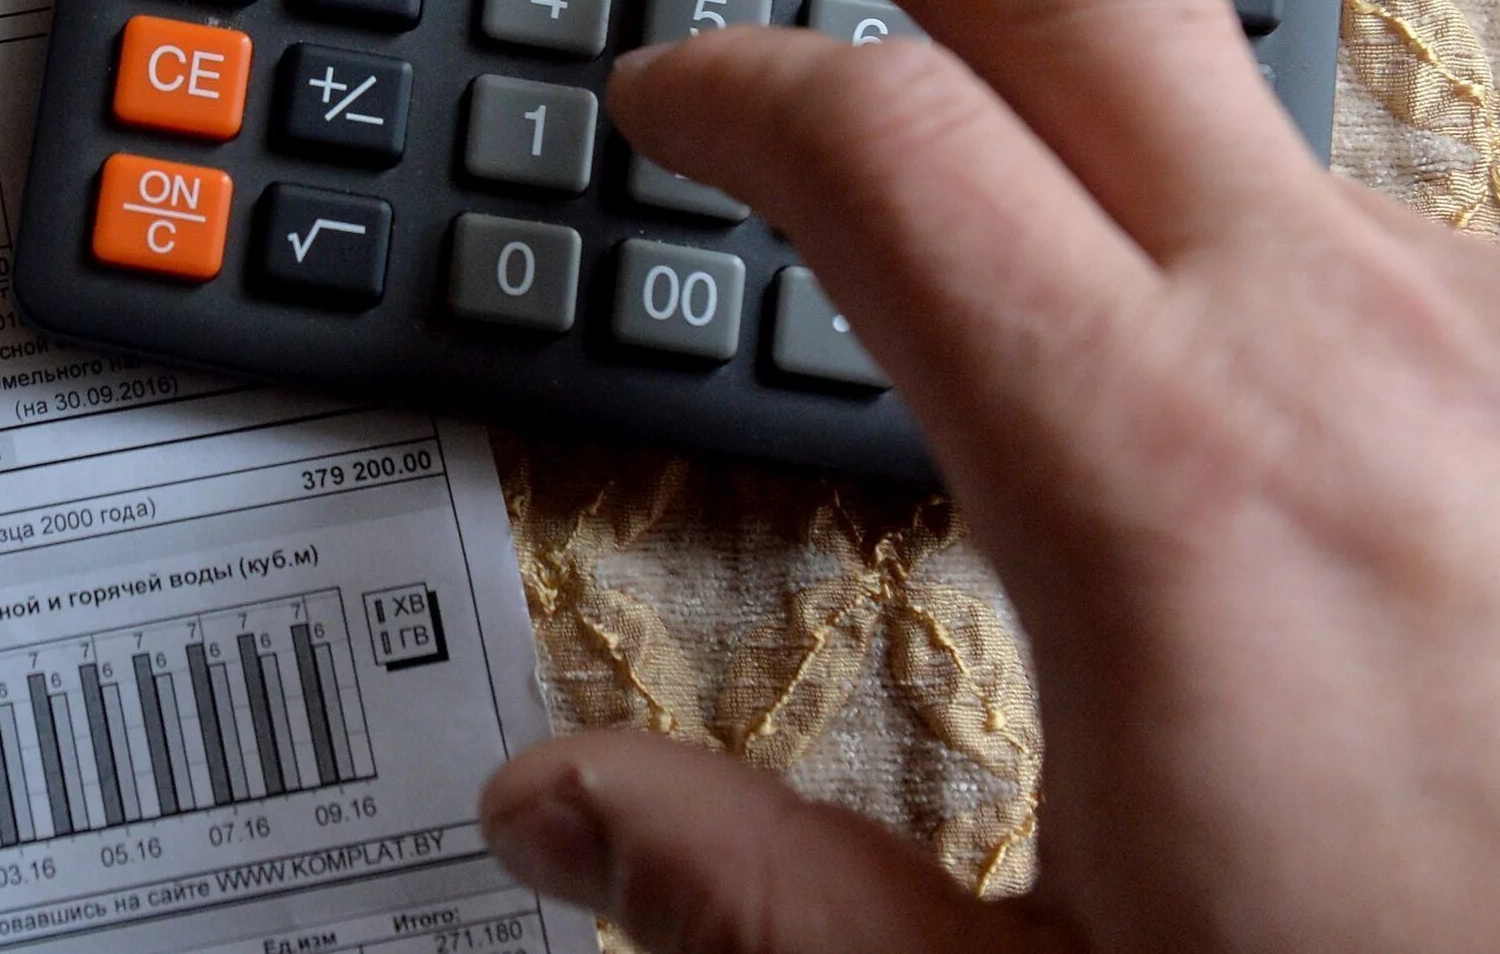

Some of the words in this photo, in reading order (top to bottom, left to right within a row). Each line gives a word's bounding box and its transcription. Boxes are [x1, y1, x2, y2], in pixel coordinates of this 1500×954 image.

[147, 45, 224, 99] CE
[524, 105, 547, 156] 1
[139, 170, 200, 210] ON
[146, 222, 176, 254] C
[498, 242, 535, 296] 0
[642, 265, 717, 328] 00
[354, 450, 432, 482] 200.00
[42, 509, 92, 533] 2000
[101, 497, 157, 526] года)
[69, 569, 162, 611] горячей
[239, 546, 319, 579] (куб.м)
[393, 594, 425, 617] ХВ
[400, 626, 430, 649] ГВ
[316, 798, 376, 826] 09.16
[209, 820, 270, 847] 07.16
